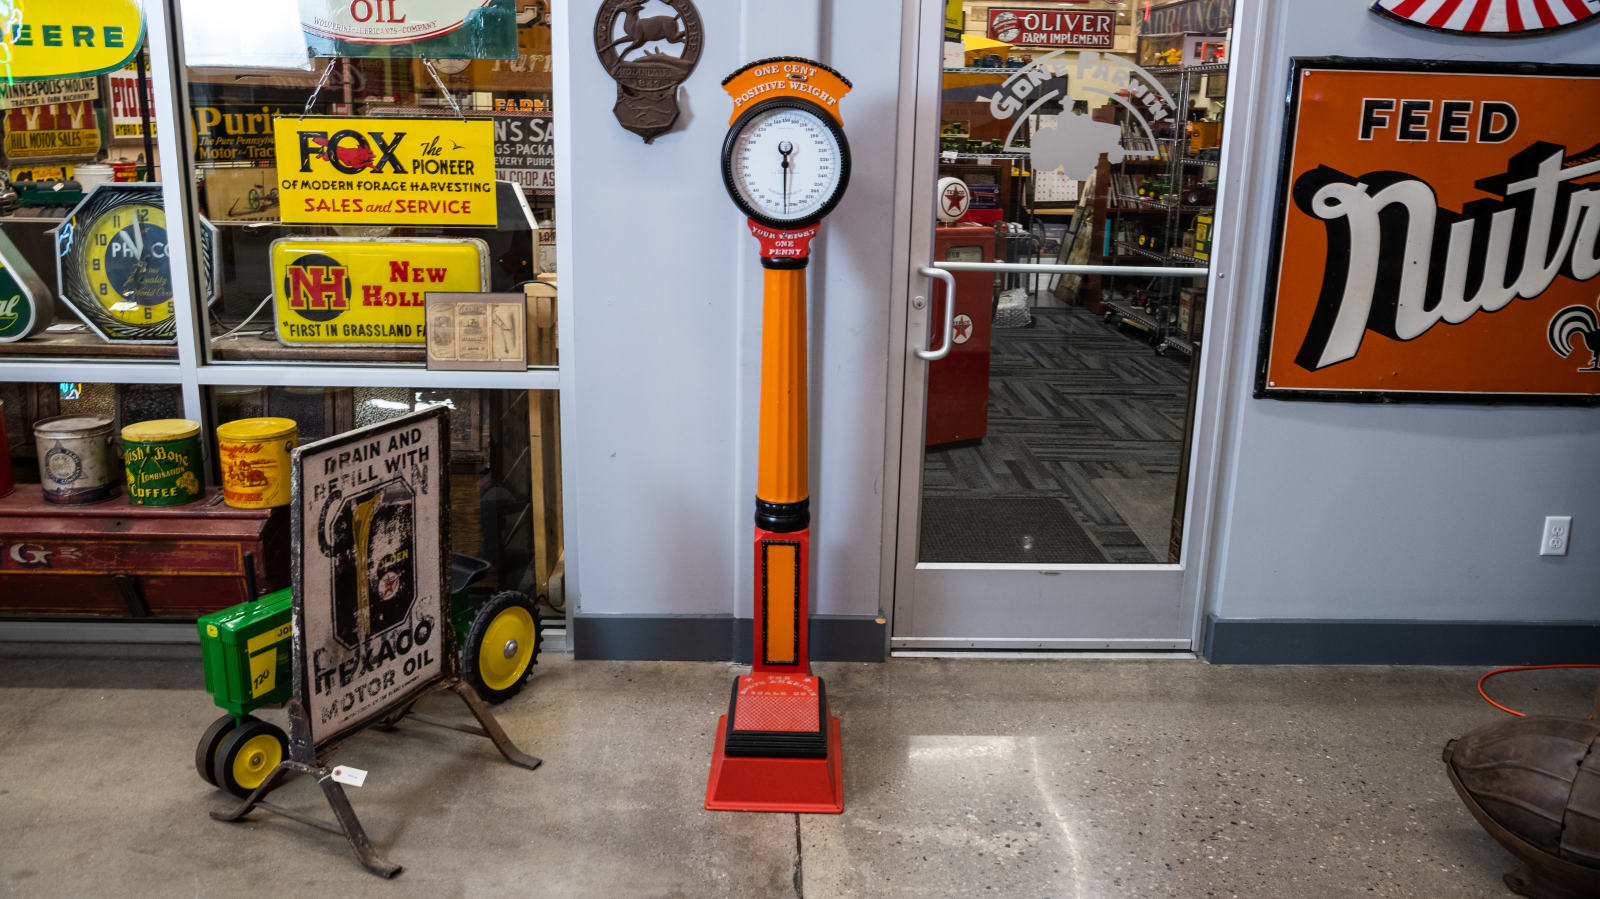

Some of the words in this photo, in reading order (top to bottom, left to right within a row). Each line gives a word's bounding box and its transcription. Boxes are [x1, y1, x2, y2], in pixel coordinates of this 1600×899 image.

[350, 0, 406, 23] OIL
[1023, 13, 1111, 33] OLIVER
[0, 24, 124, 48] EERE
[1022, 32, 1047, 44] FARM
[1050, 33, 1110, 45] IMPLEMENTS
[754, 65, 780, 77] ONE
[784, 64, 818, 77] CENT
[734, 80, 786, 107] POSITIVE
[789, 80, 837, 107] WEIGHT
[990, 59, 1069, 120] GONE
[1358, 98, 1520, 144] FEED
[200, 146, 238, 159] Motor
[297, 130, 408, 174] FOX
[421, 136, 442, 157] The
[412, 159, 475, 175] PIONEER
[282, 180, 298, 190] OF
[300, 180, 353, 192] MODERN
[356, 181, 407, 192] FORAGE
[410, 181, 491, 193] HARVESTING
[304, 198, 363, 213] SALES
[365, 200, 392, 214] and
[395, 200, 472, 215] SERVICE
[136, 208, 149, 222] 12
[95, 233, 107, 246] 10
[768, 248, 802, 256] PENNY
[92, 258, 100, 271] 9
[99, 283, 108, 296] 8
[288, 265, 349, 311] NH
[144, 307, 152, 320] 6
[326, 324, 338, 337] IN
[343, 324, 412, 337] GRASSLAND
[387, 427, 422, 453] AND
[154, 446, 189, 467] Bone
[384, 445, 430, 474] WITH
[131, 484, 178, 498] COFFEE
[402, 649, 434, 677] OIL
